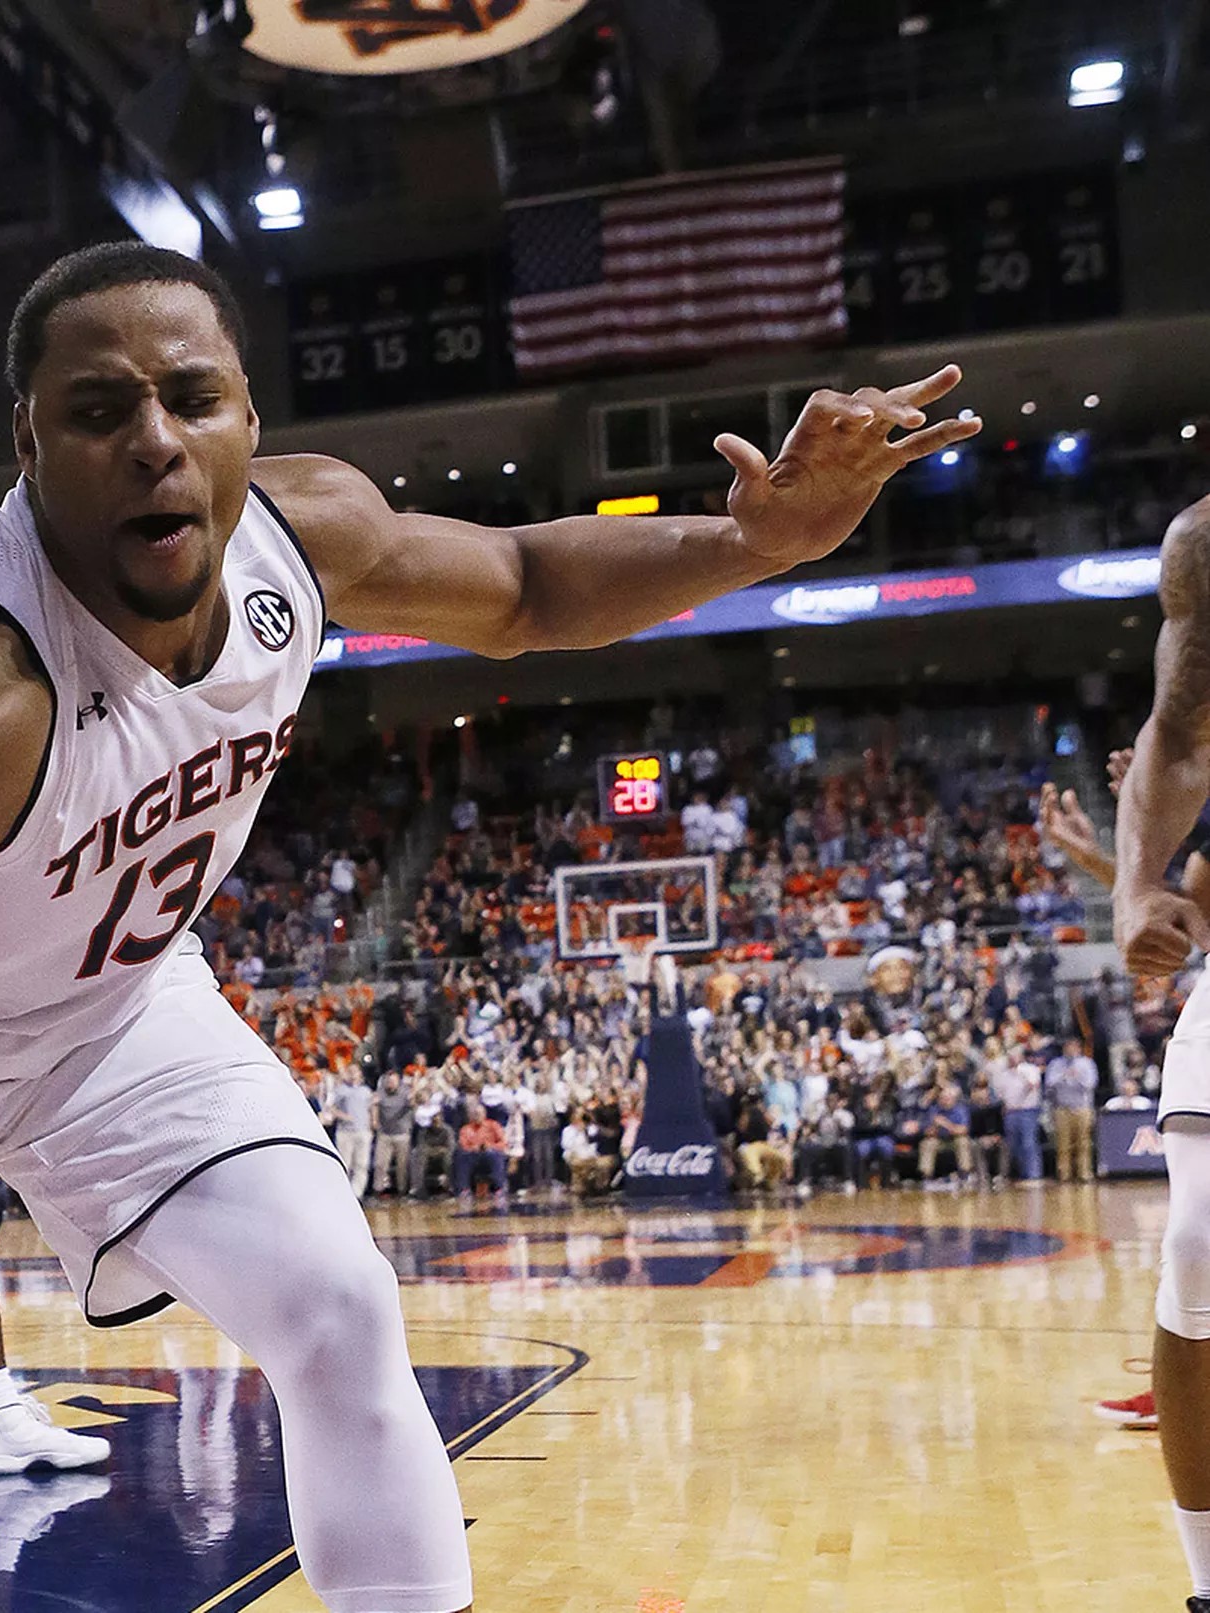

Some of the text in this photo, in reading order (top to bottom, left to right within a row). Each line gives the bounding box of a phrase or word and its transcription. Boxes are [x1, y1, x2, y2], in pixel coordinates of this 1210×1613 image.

[302, 344, 345, 380] 32
[373, 334, 408, 371] 15
[434, 325, 482, 364] 30
[246, 592, 292, 649] SEC
[614, 779, 656, 814] 28
[75, 830, 217, 980] 13
